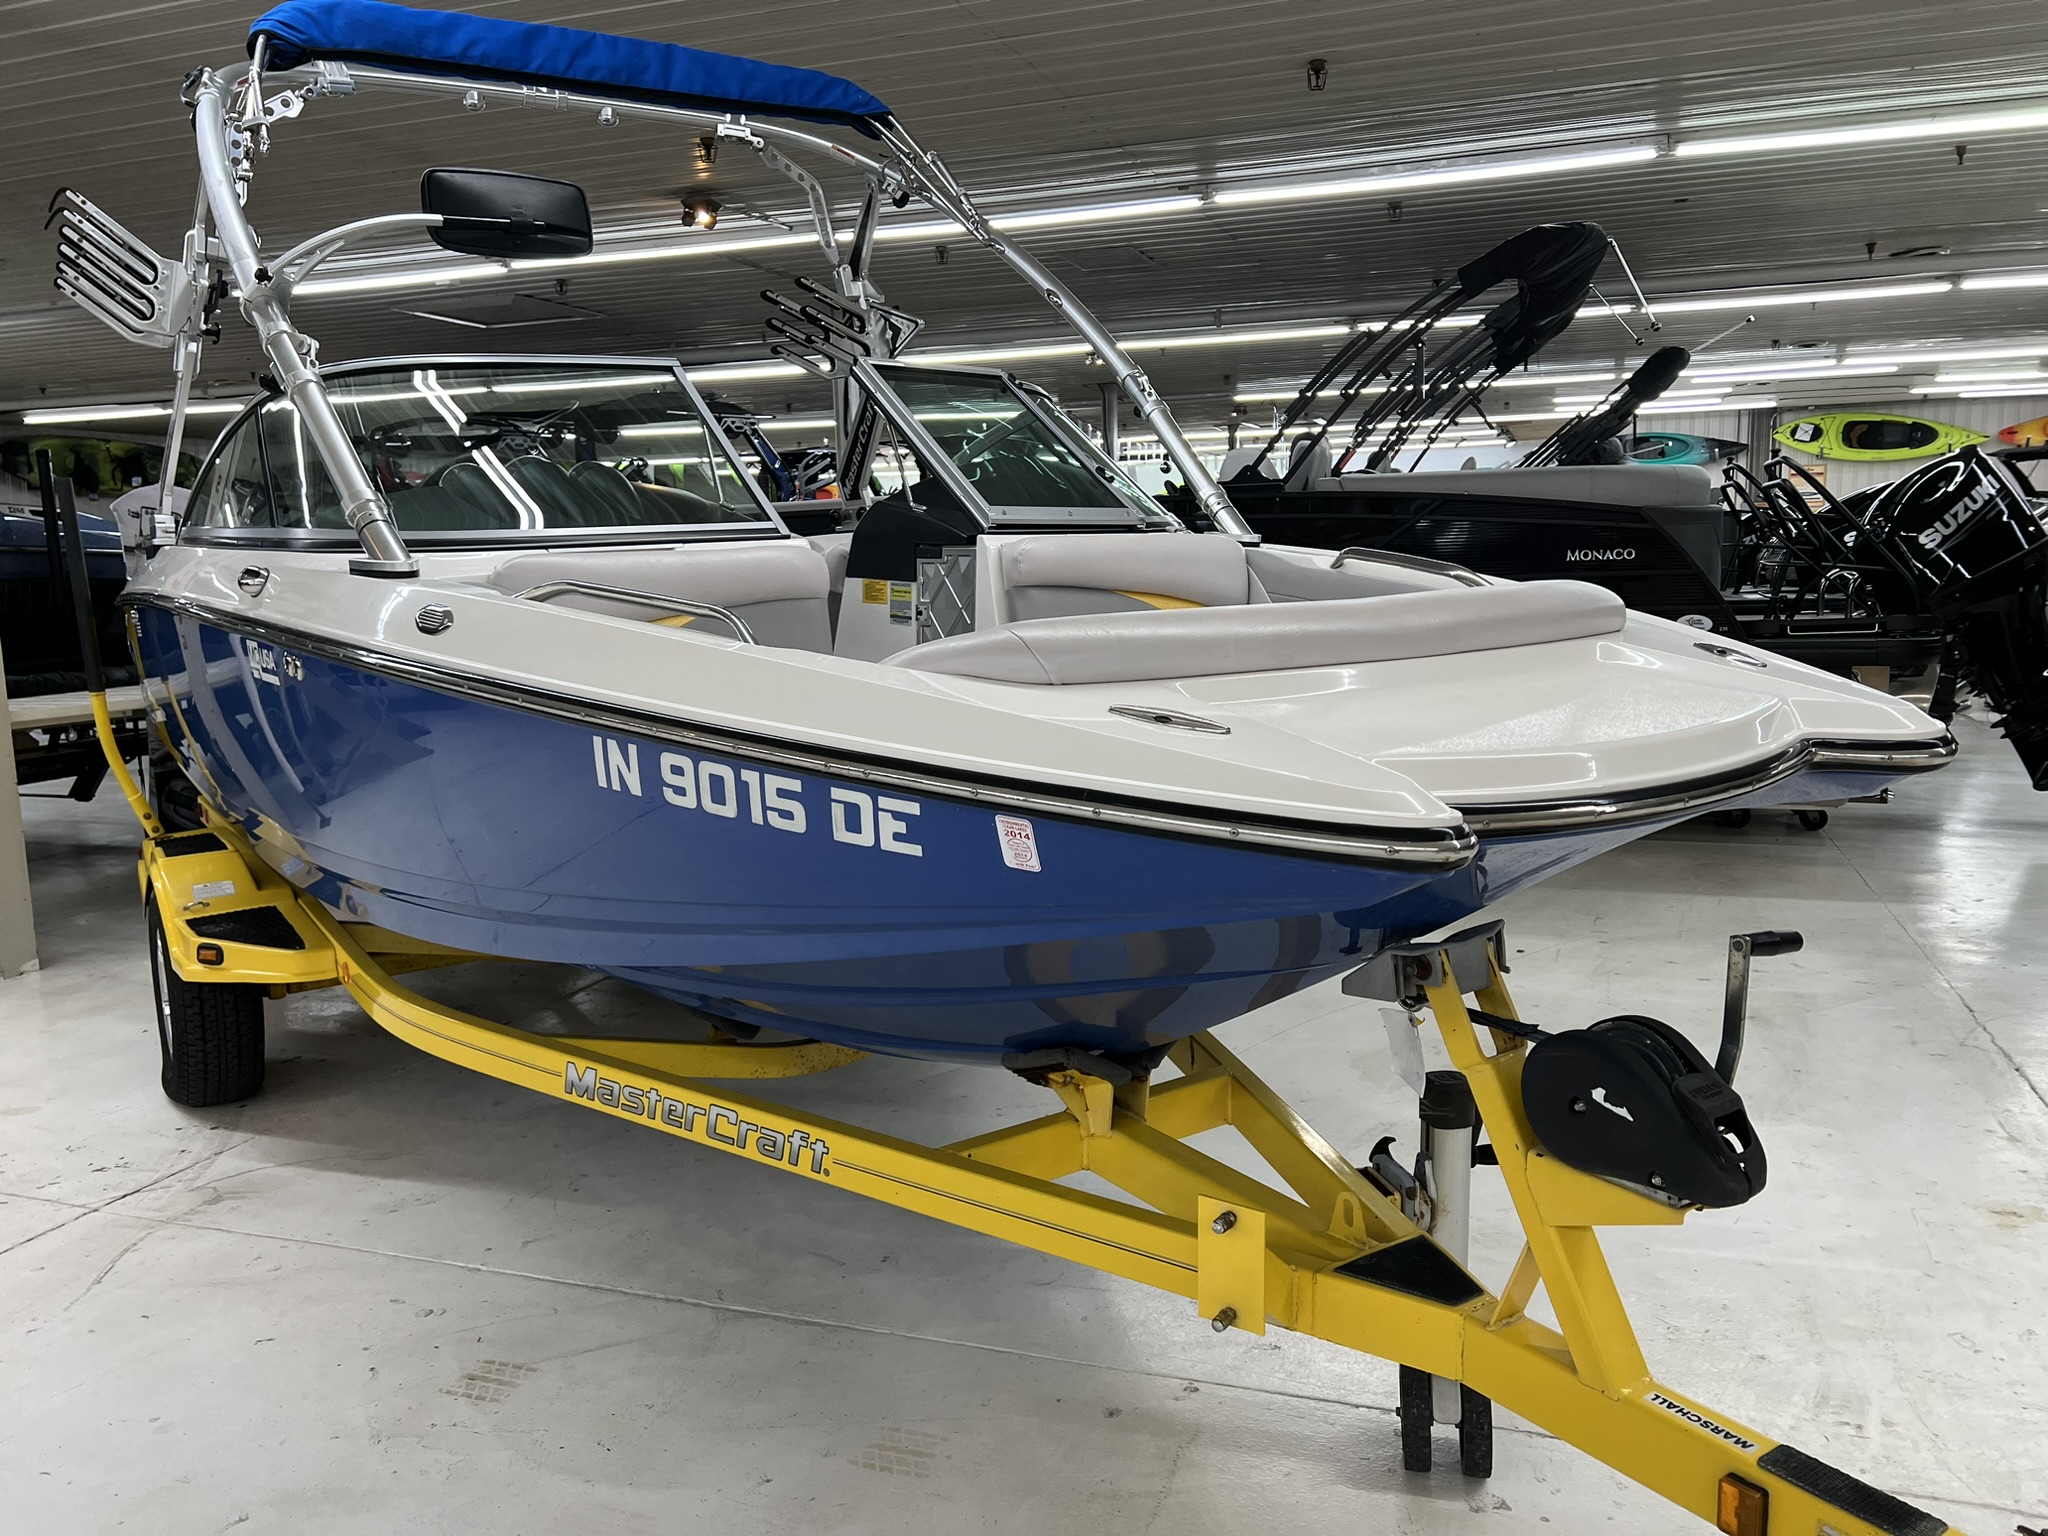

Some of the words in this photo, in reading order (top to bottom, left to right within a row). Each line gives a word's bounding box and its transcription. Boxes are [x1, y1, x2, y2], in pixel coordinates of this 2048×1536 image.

[1918, 473, 2001, 549] SUZUKI
[1566, 548, 1636, 561] MONACO
[593, 735, 642, 797] IN
[660, 752, 807, 834] 9015
[830, 786, 923, 857] DE
[1003, 829, 1031, 840] 2014
[564, 1061, 830, 1176] MasterCraft
[1651, 1393, 1754, 1449] MARSCHALL
